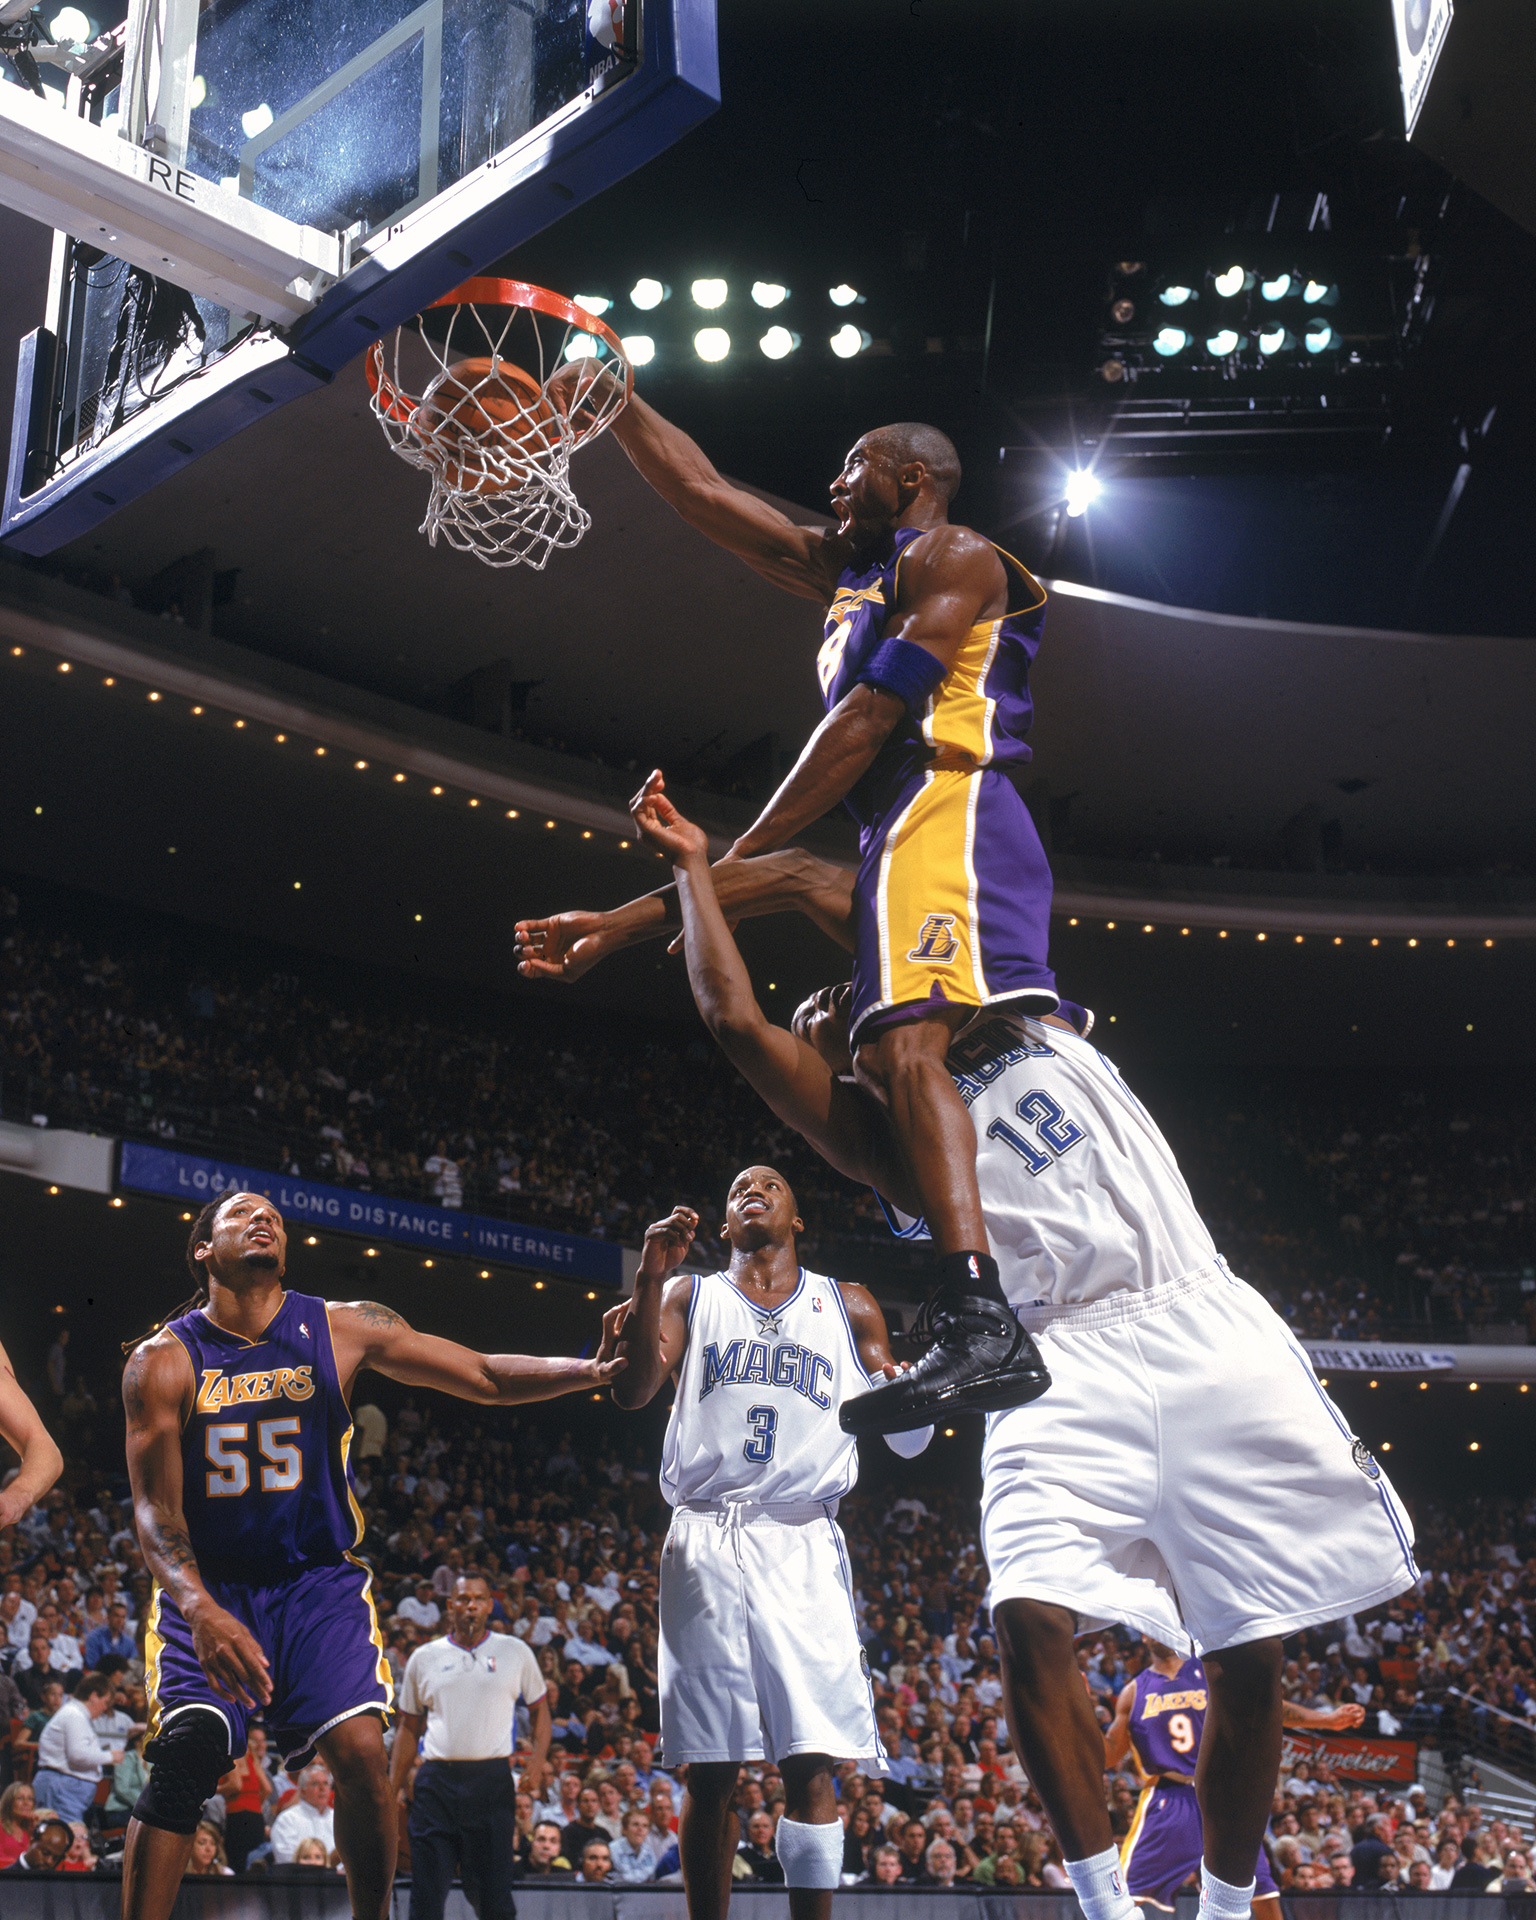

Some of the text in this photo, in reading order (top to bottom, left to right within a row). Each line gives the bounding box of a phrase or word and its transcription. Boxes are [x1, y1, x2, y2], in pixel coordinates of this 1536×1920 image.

[589, 54, 613, 84] NBA
[817, 618, 852, 697] 8
[944, 1017, 1057, 1108] AGIC
[986, 1088, 1087, 1177] 12
[281, 1188, 340, 1216] LONG
[349, 1202, 453, 1240] DISTANCE
[479, 1229, 574, 1263] INTERNET
[196, 1365, 315, 1414] LAKERS
[698, 1338, 833, 1411] MAGIC
[205, 1416, 303, 1498] 55
[743, 1404, 778, 1464] 3
[1141, 1689, 1208, 1721] LAKERS
[1168, 1713, 1195, 1754] 9
